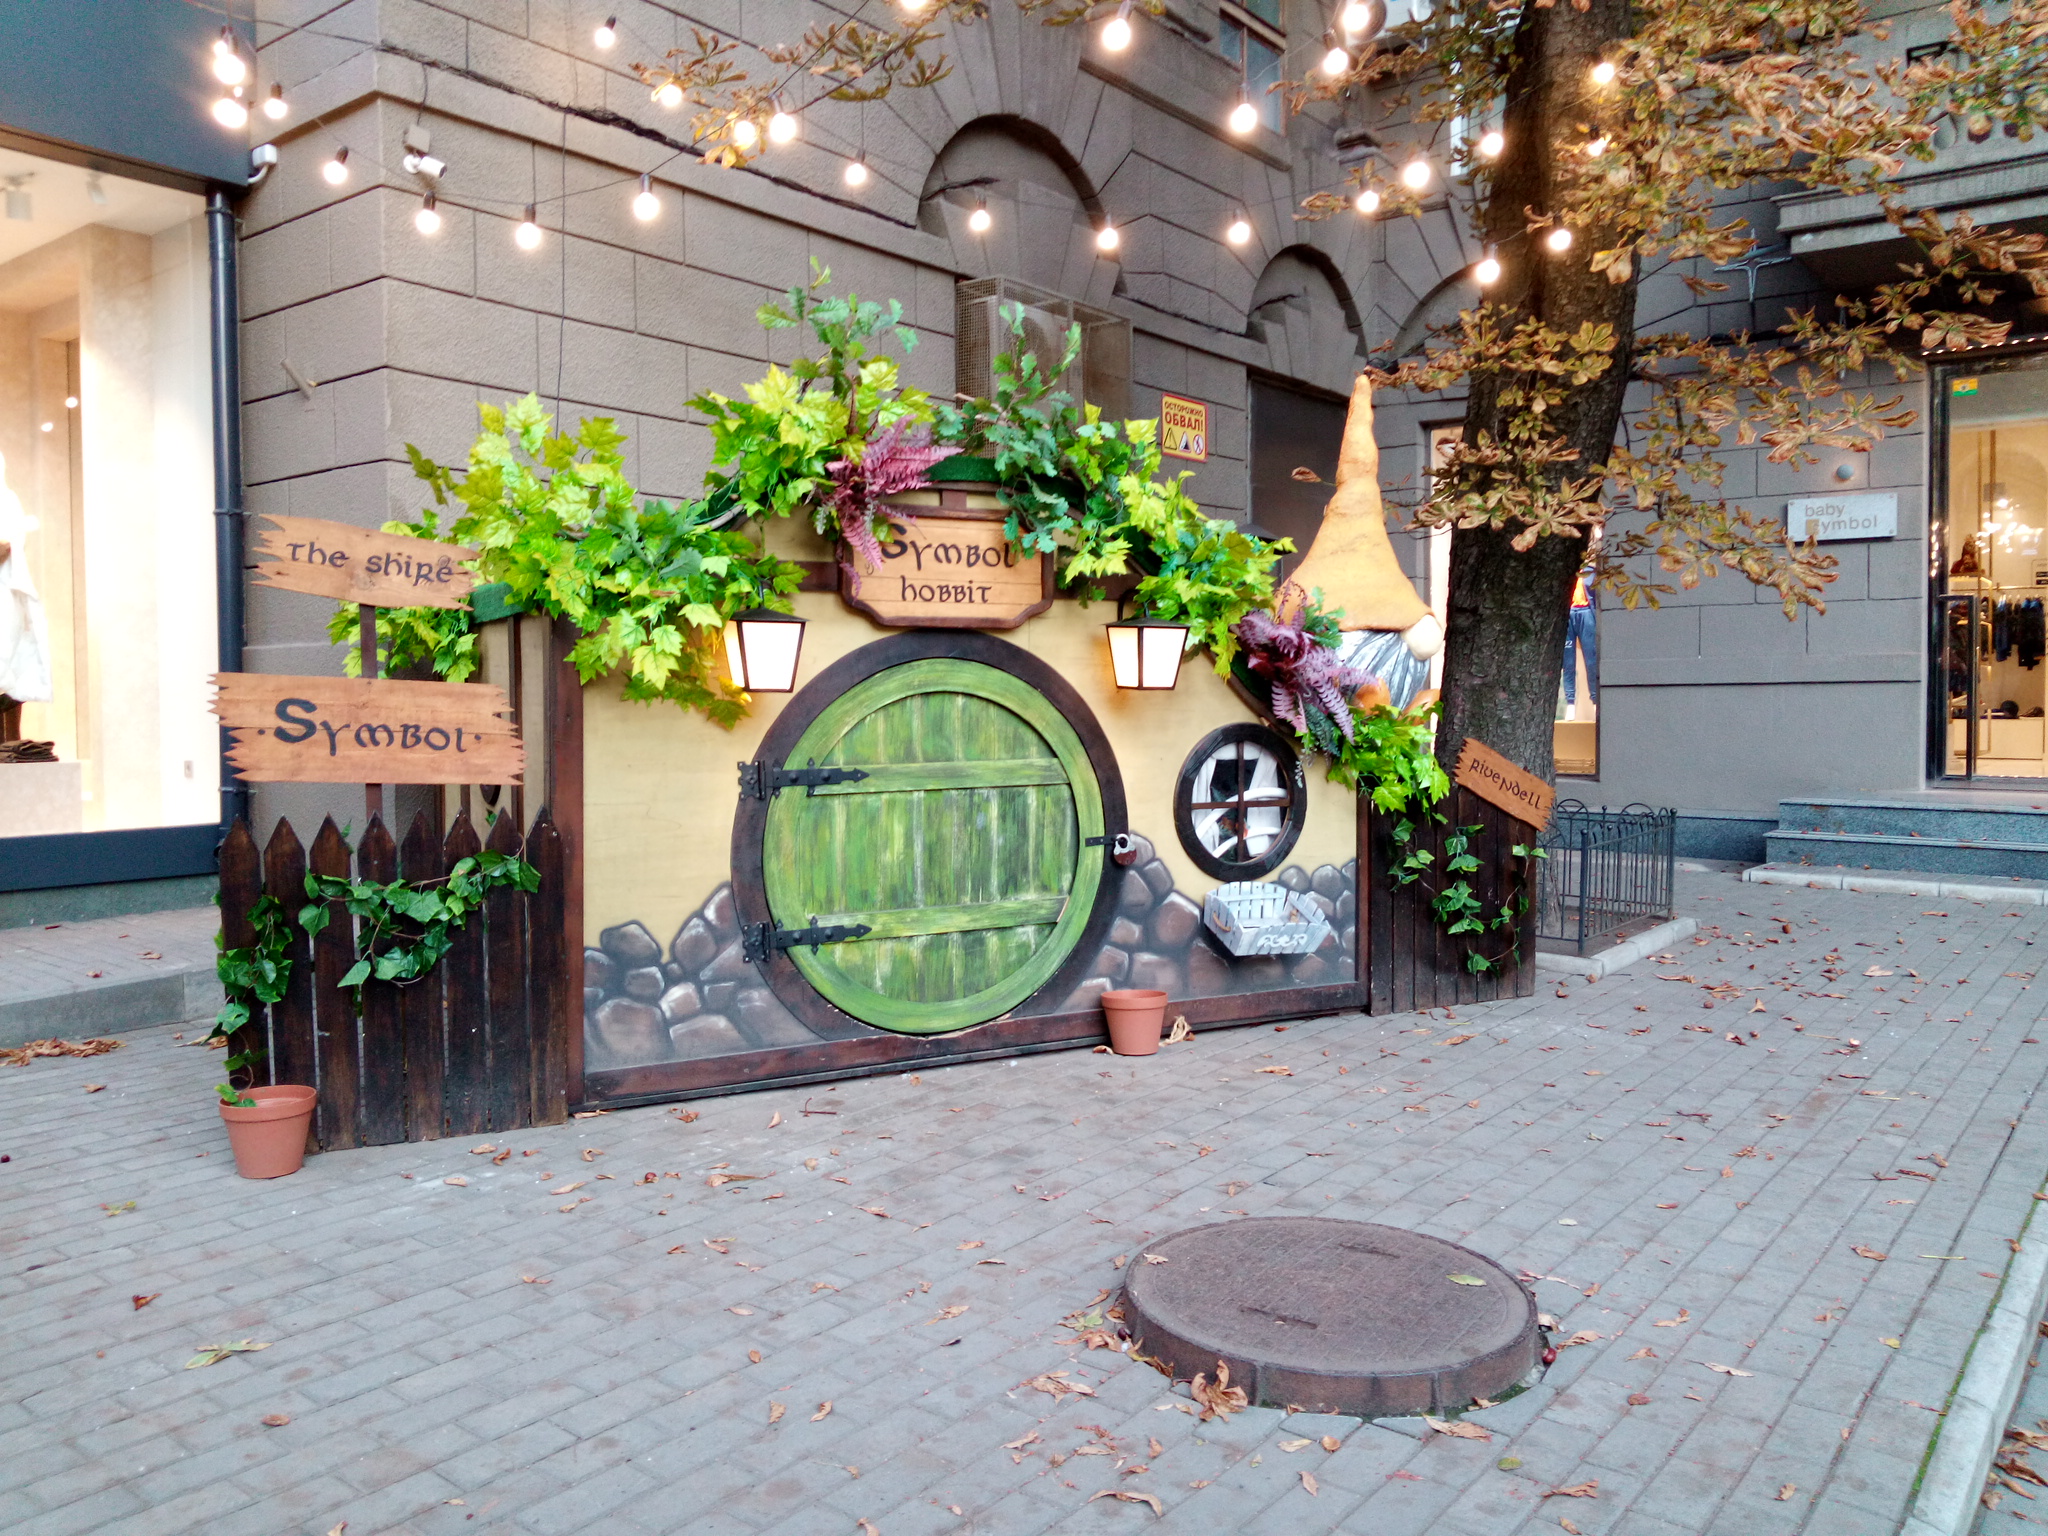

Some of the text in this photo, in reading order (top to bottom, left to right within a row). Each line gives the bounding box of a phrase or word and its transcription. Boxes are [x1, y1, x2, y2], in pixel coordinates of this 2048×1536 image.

[1164, 401, 1203, 417] ОСТОРОЖНО
[1165, 411, 1203, 432] ОБВАЛ!
[1805, 503, 1845, 517] baby
[286, 541, 349, 567] The
